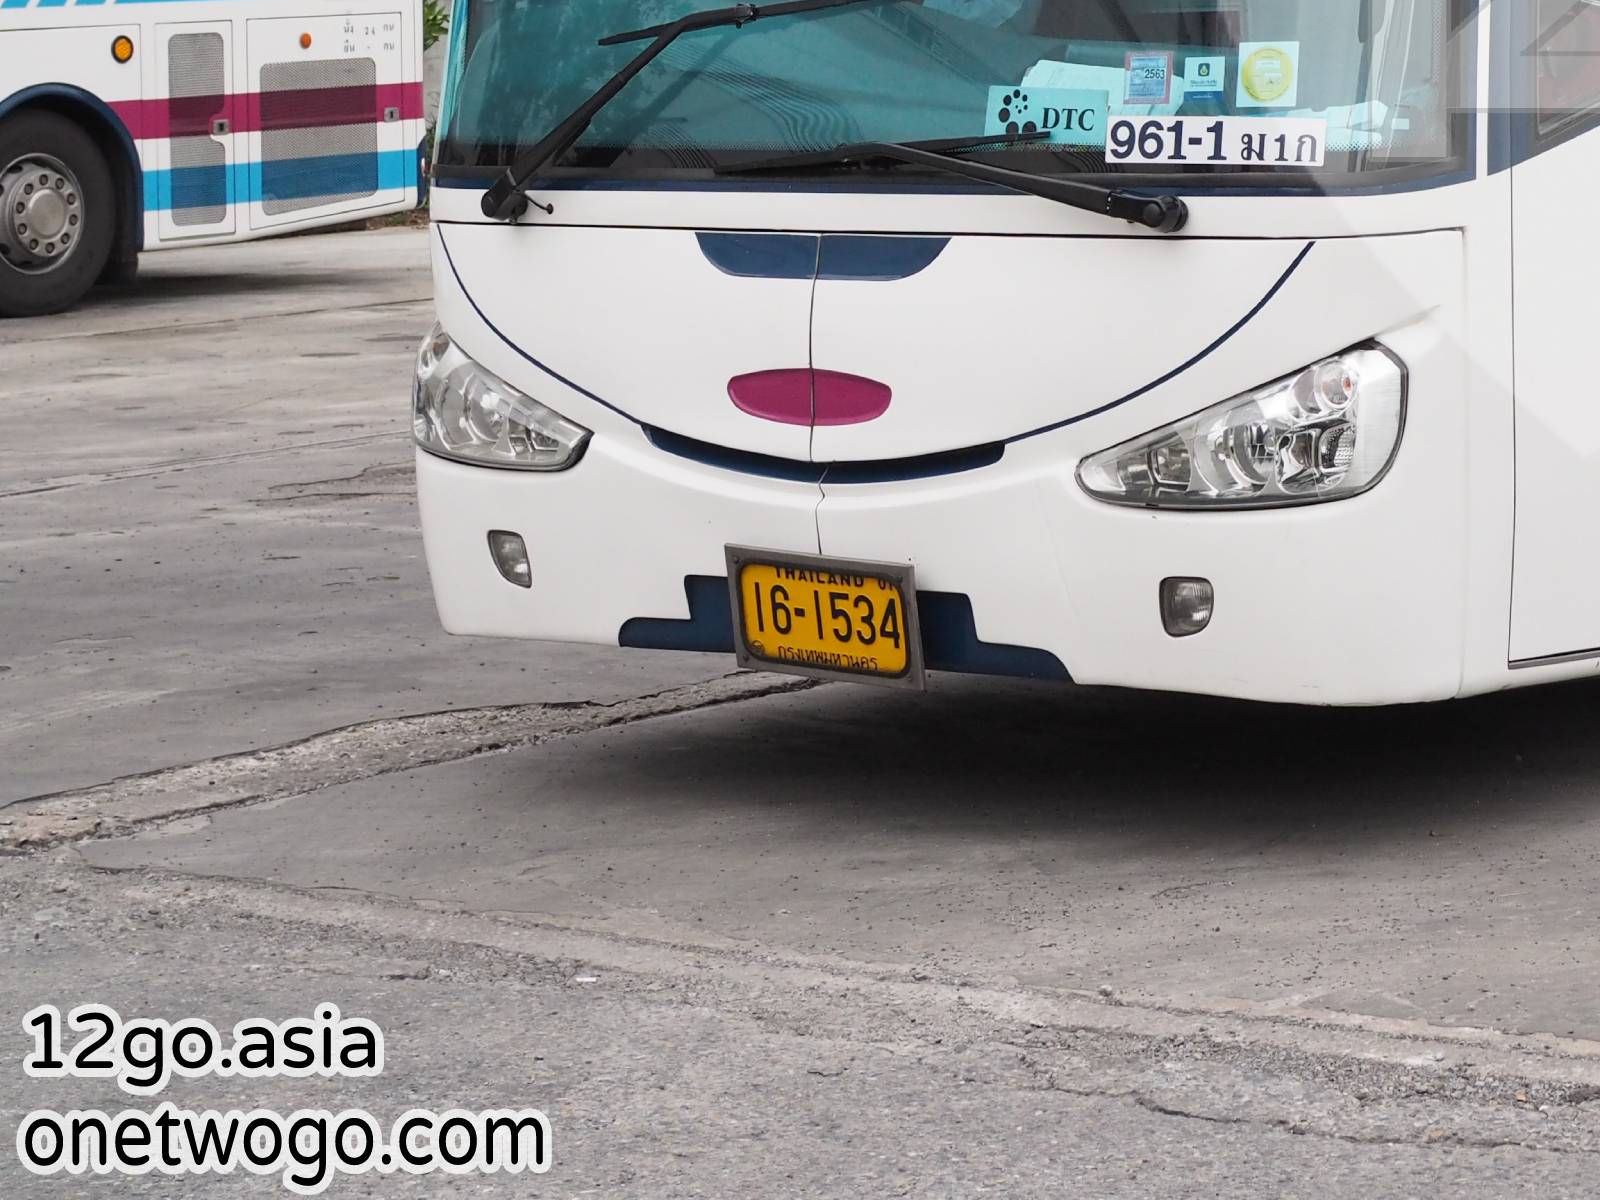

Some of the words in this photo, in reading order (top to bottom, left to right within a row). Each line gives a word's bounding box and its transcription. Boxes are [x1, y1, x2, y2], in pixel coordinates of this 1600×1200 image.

[1144, 68, 1165, 80] 2563
[1041, 106, 1095, 132] DTC
[1109, 119, 1228, 161] 961-1
[754, 581, 900, 649] 16-1534
